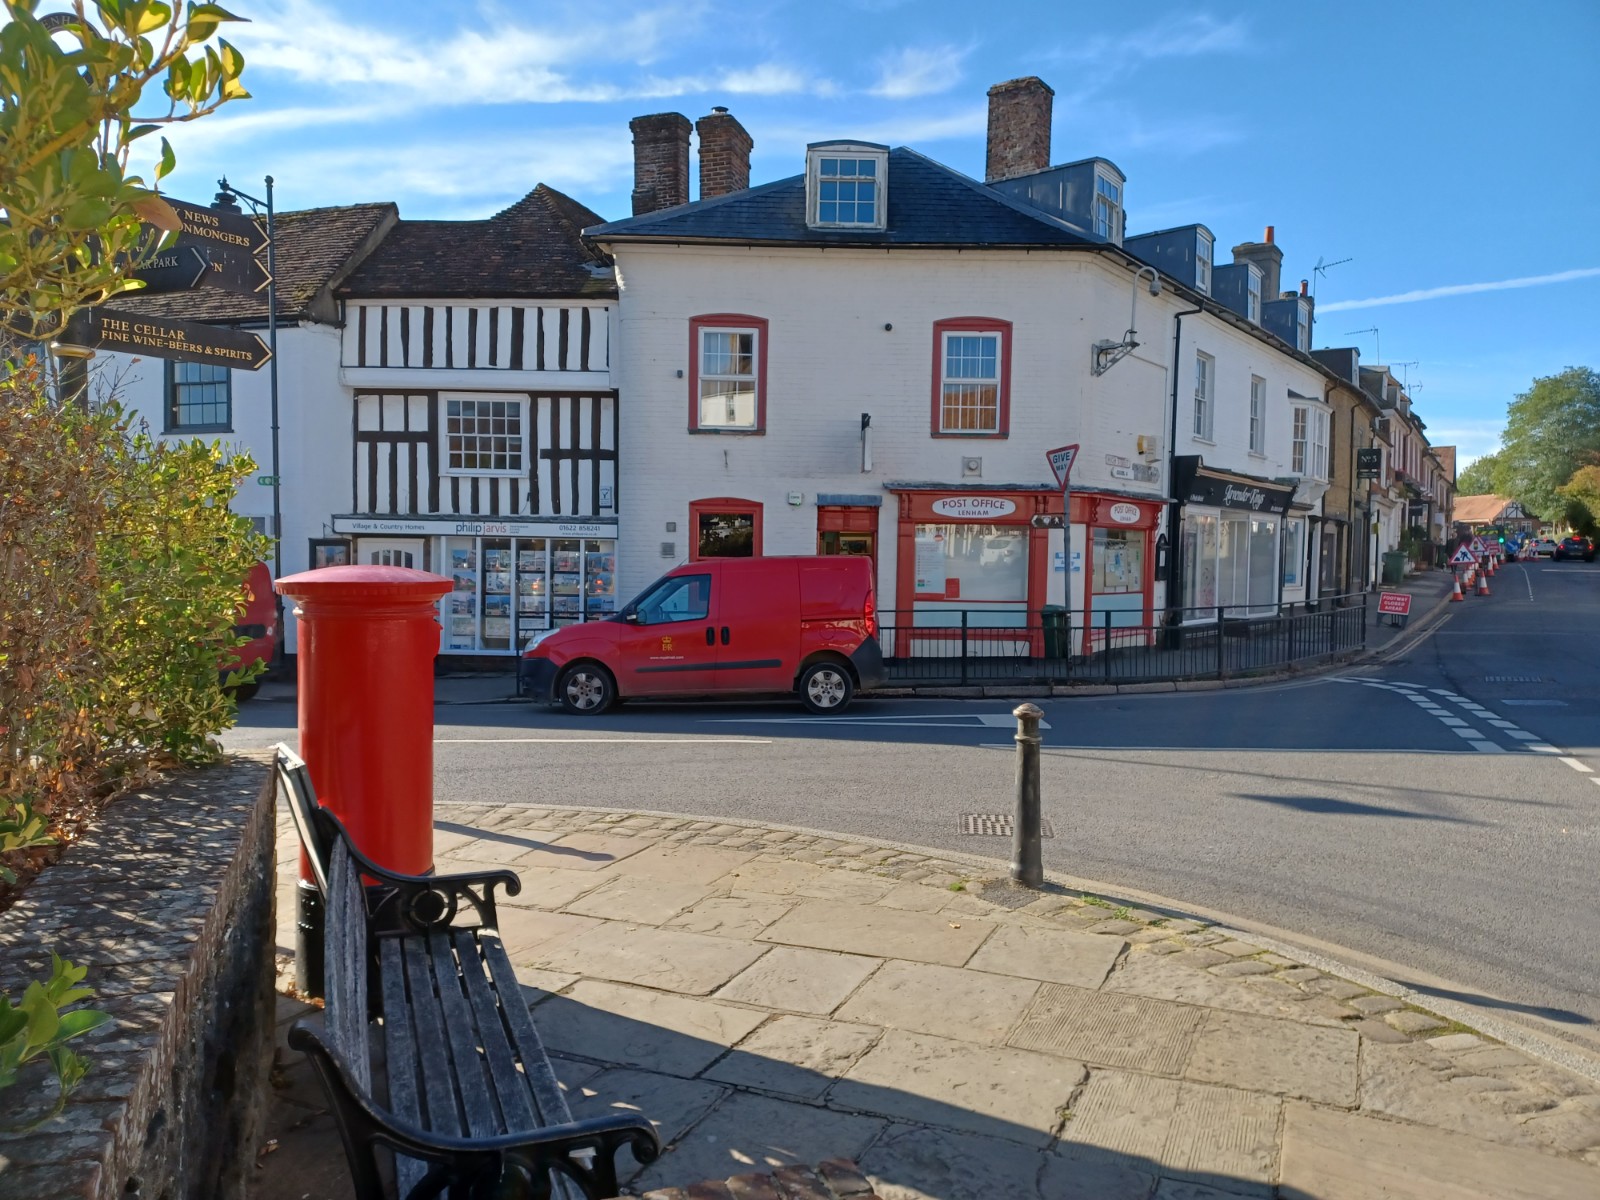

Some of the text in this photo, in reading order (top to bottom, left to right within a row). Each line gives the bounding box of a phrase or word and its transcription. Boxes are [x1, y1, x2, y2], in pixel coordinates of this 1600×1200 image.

[184, 209, 219, 227] NEWS
[153, 256, 179, 269] PARK
[101, 318, 186, 341] THE CELLAR
[101, 330, 253, 361] FINE WINE-BEERS & SPIRITS
[1052, 452, 1071, 463] GIVE
[942, 499, 1005, 509] POST OFFICE
[1114, 505, 1137, 516] POST OFFICE
[455, 522, 482, 535] philip
[483, 522, 507, 535] jarvis
